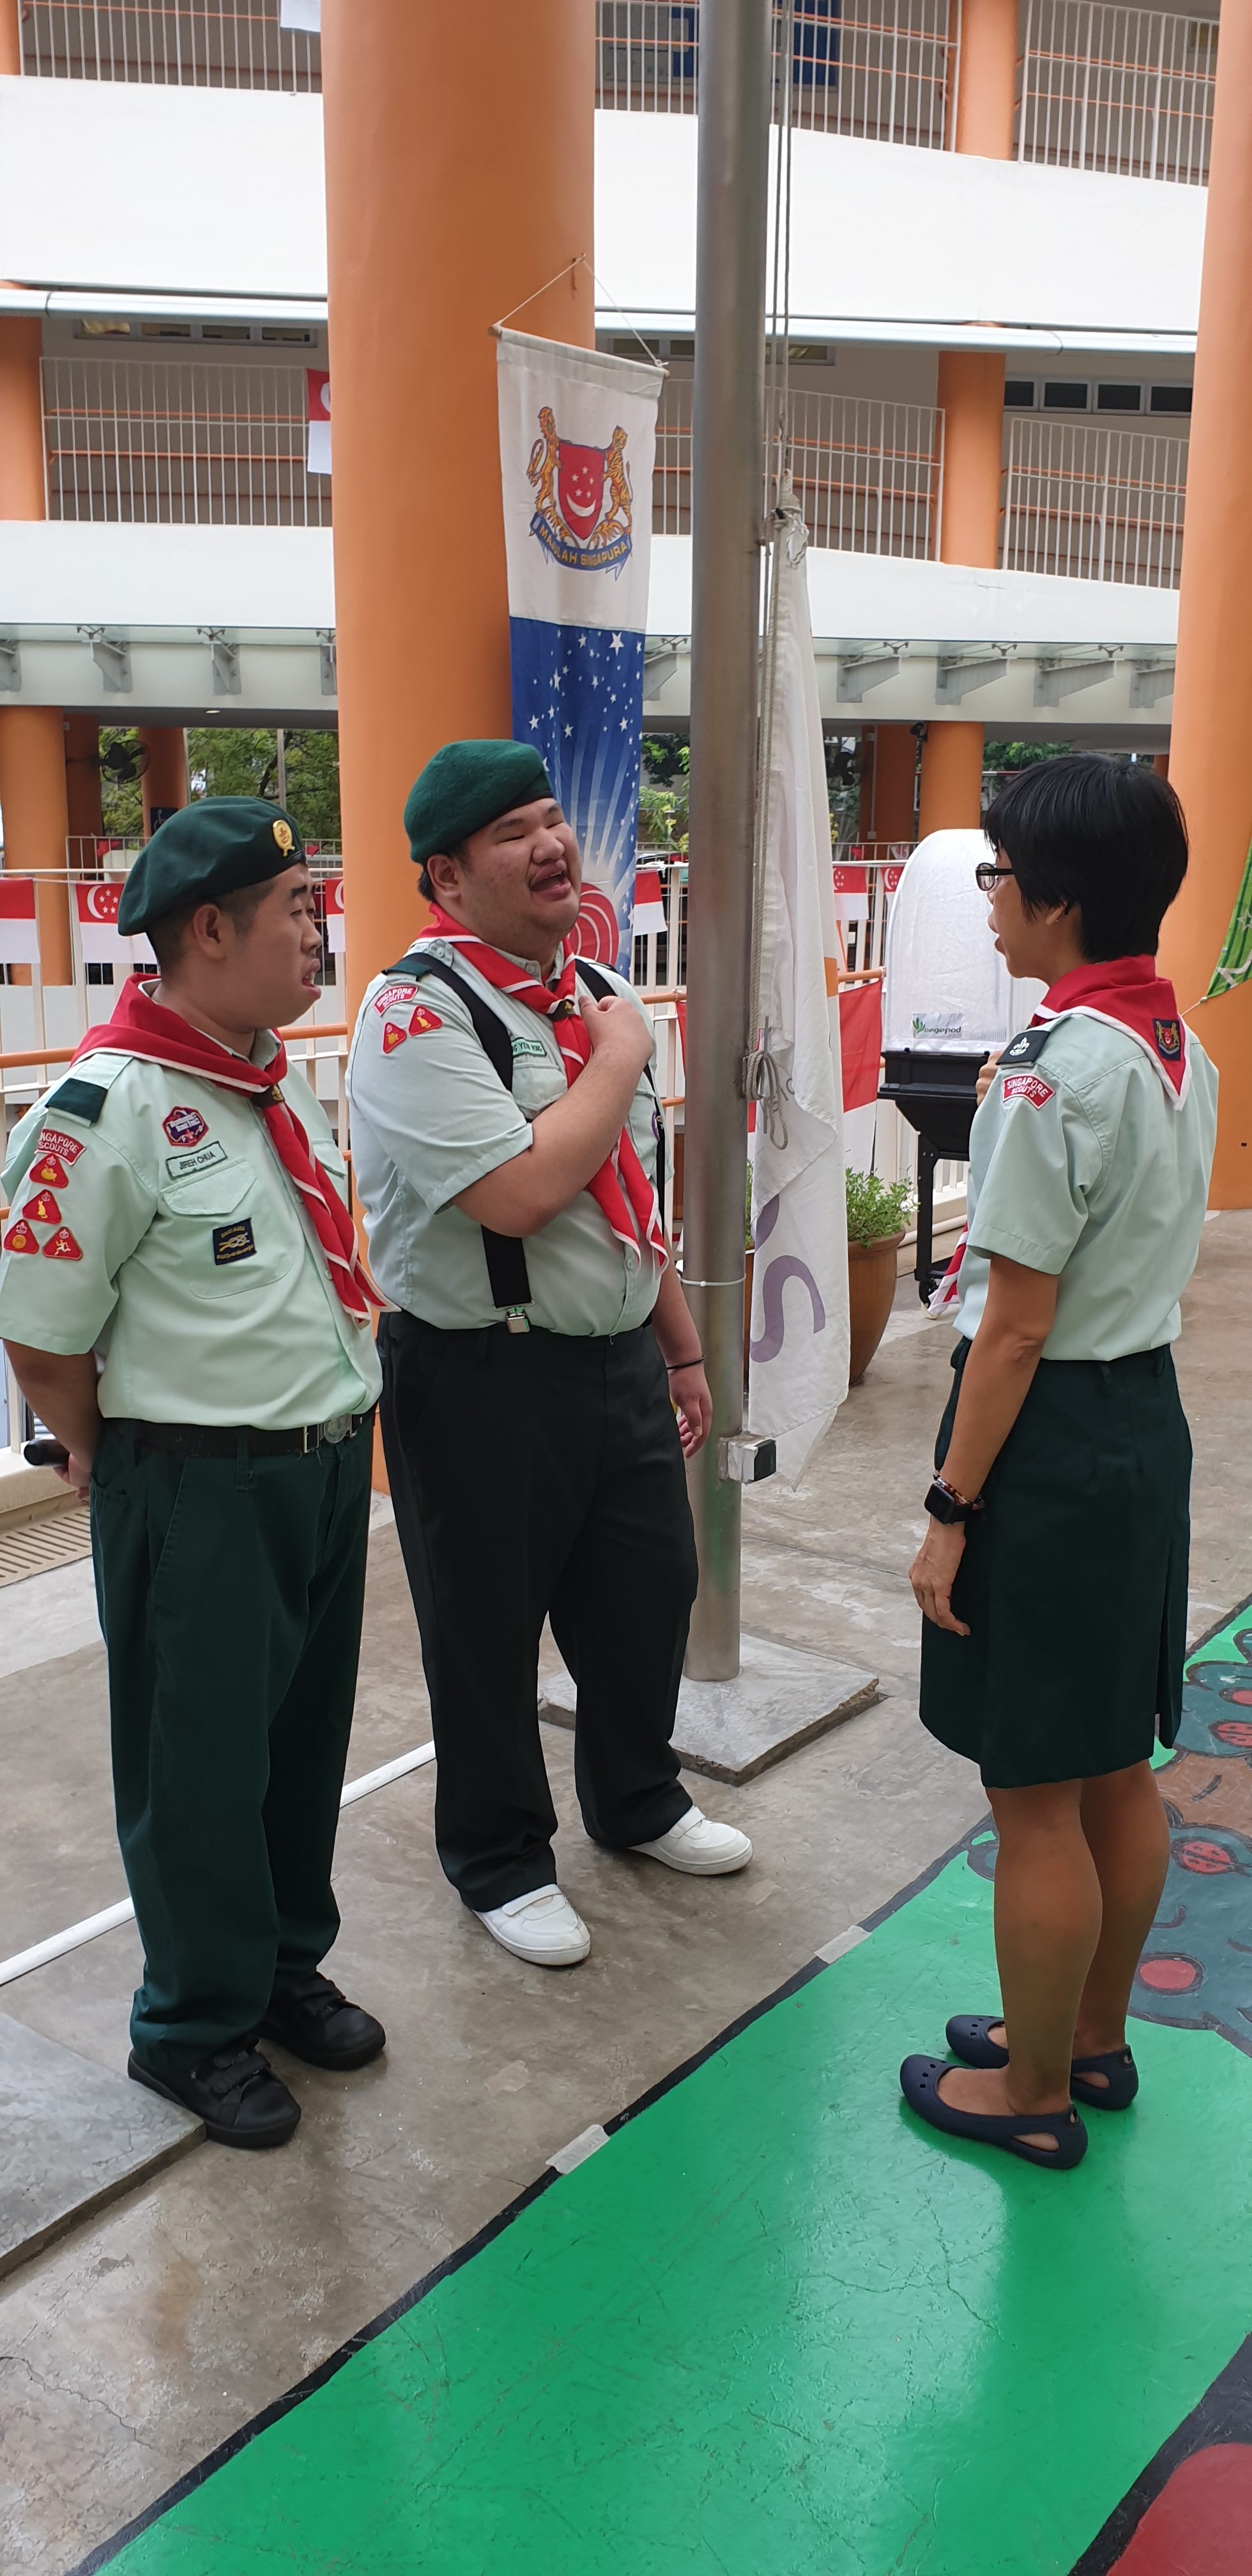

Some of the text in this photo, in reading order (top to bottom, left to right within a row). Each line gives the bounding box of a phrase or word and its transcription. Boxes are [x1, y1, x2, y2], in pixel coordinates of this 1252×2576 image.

[1007, 1077, 1048, 1098] SINGAPORE
[1011, 1085, 1036, 1098] SCOUTS
[38, 1141, 69, 1156] SCOUTS
[197, 1151, 216, 1163] CHUA
